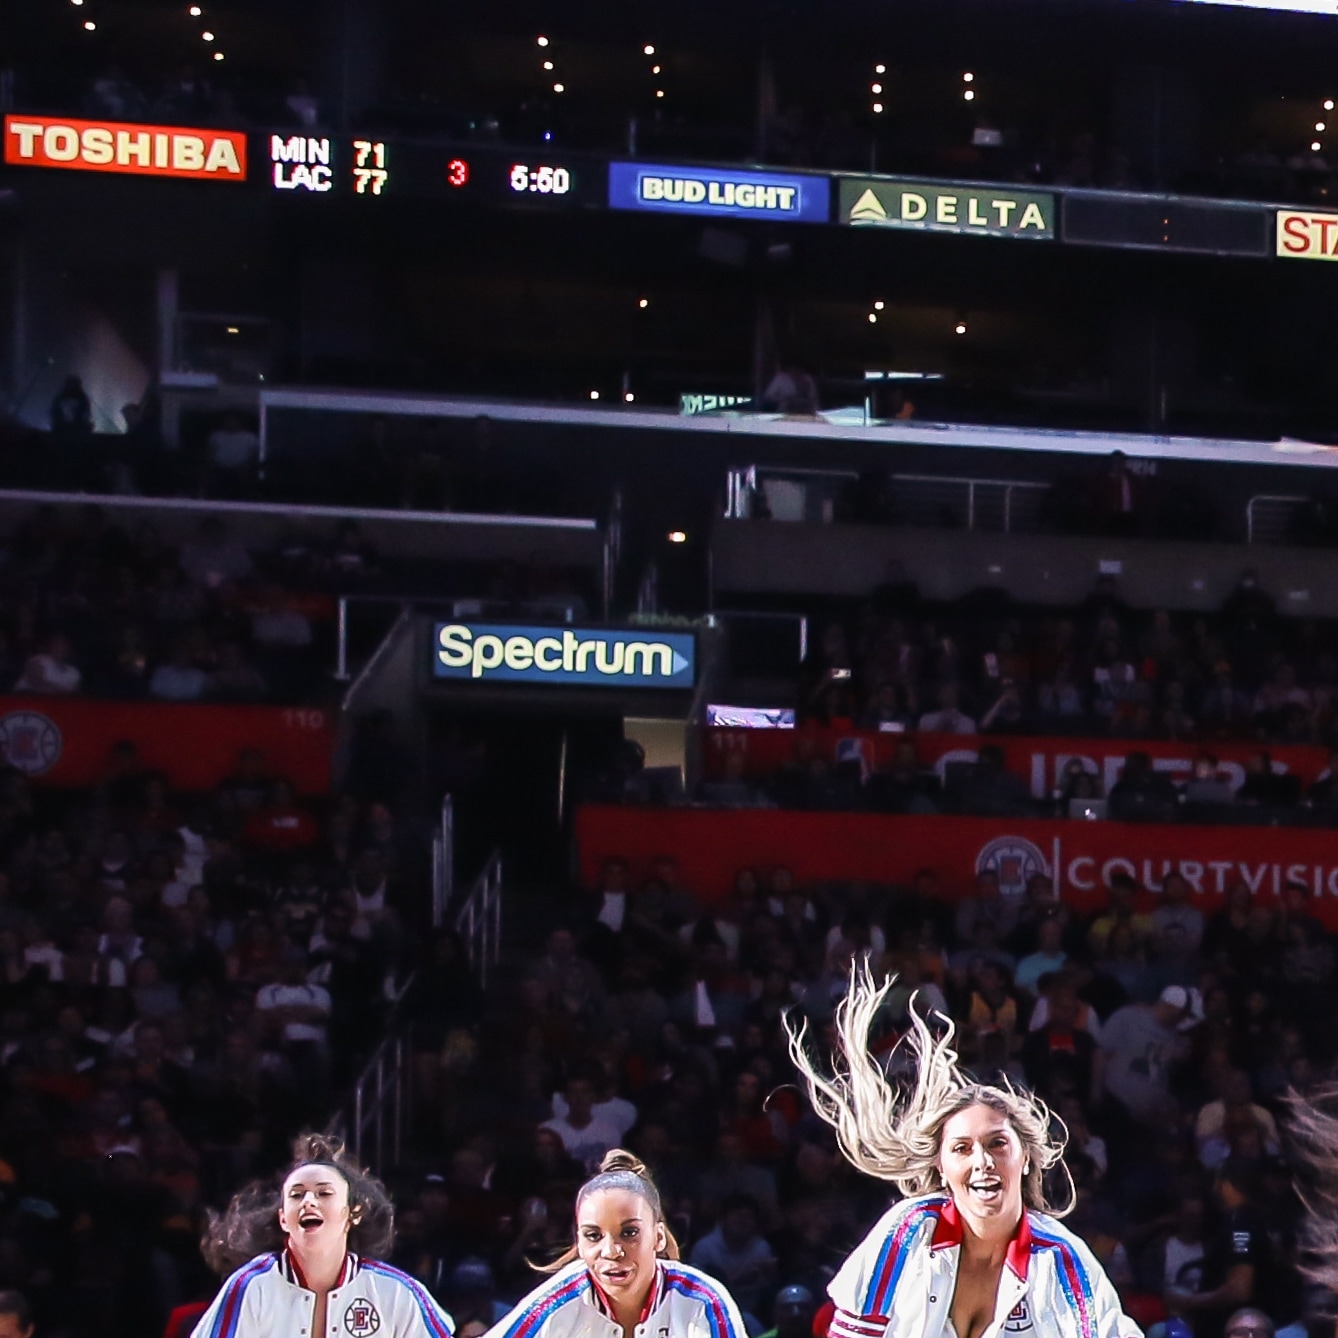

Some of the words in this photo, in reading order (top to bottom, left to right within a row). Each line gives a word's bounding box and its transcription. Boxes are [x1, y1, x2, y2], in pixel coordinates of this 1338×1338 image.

[9, 122, 241, 174] TOSHIBA
[271, 135, 330, 166] MIN
[353, 140, 386, 168] 71
[273, 166, 332, 193] LAC
[353, 168, 389, 195] 77
[449, 160, 467, 186] 3
[642, 177, 706, 203] BUD
[708, 181, 795, 210] LIGHT
[901, 192, 1046, 230] DELTA
[438, 624, 674, 678] Spectrum
